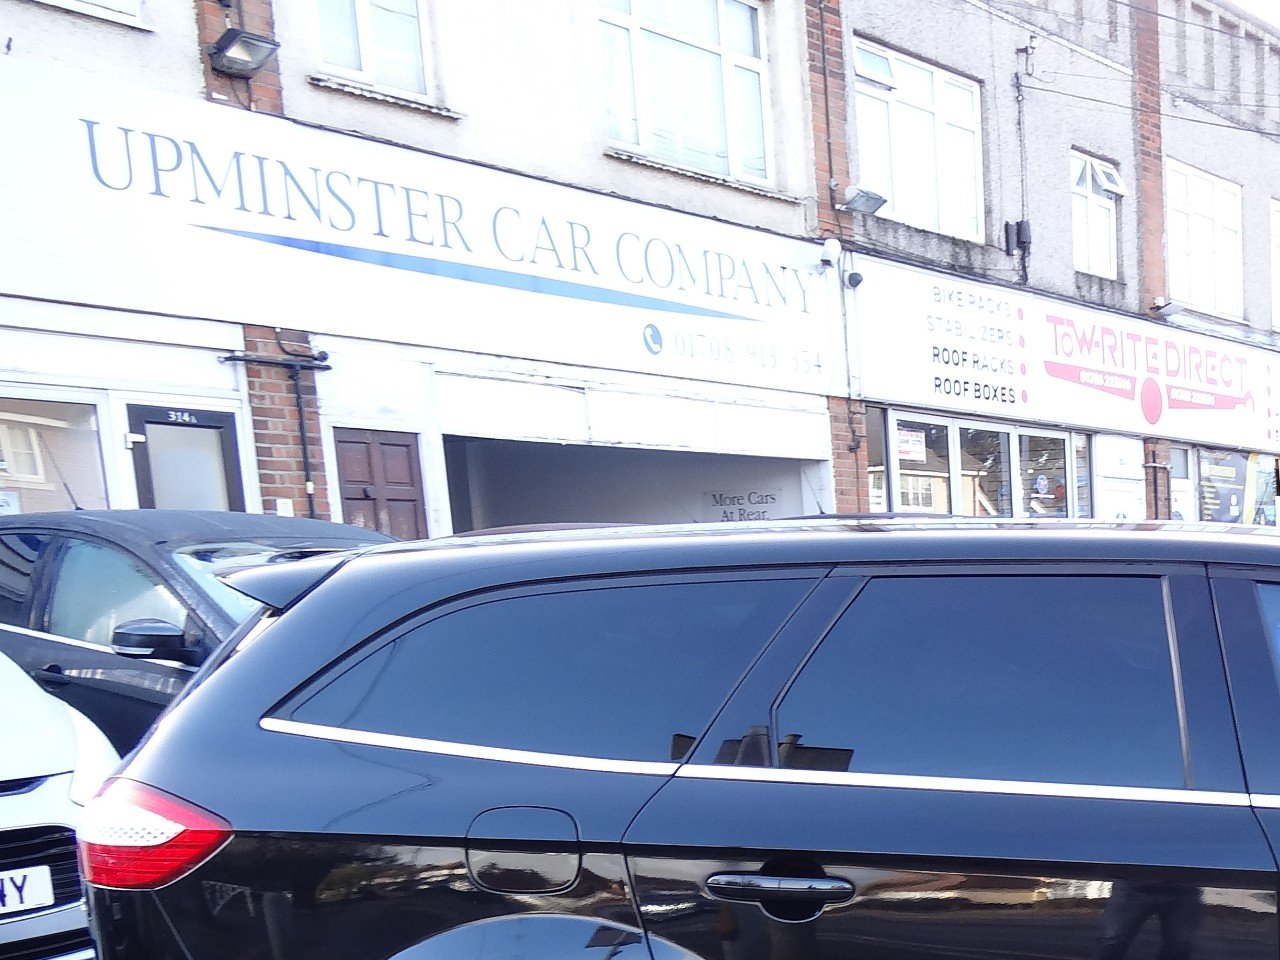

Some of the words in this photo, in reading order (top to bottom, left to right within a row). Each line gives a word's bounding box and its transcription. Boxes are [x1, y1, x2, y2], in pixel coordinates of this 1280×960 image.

[79, 118, 473, 253] UPMINSTER
[491, 205, 600, 276] CAR
[615, 231, 815, 315] COMPANY
[932, 285, 964, 308] BIKE
[968, 292, 1012, 318] RACKS
[926, 314, 1013, 346] STABILIZERS
[932, 345, 968, 367] ROOF
[972, 352, 1014, 375] RACKS
[1164, 339, 1247, 391] DIRECT
[933, 376, 970, 398] ROOF
[973, 382, 1016, 404] BOXES
[711, 493, 745, 507] More
[747, 491, 777, 506] Cars
